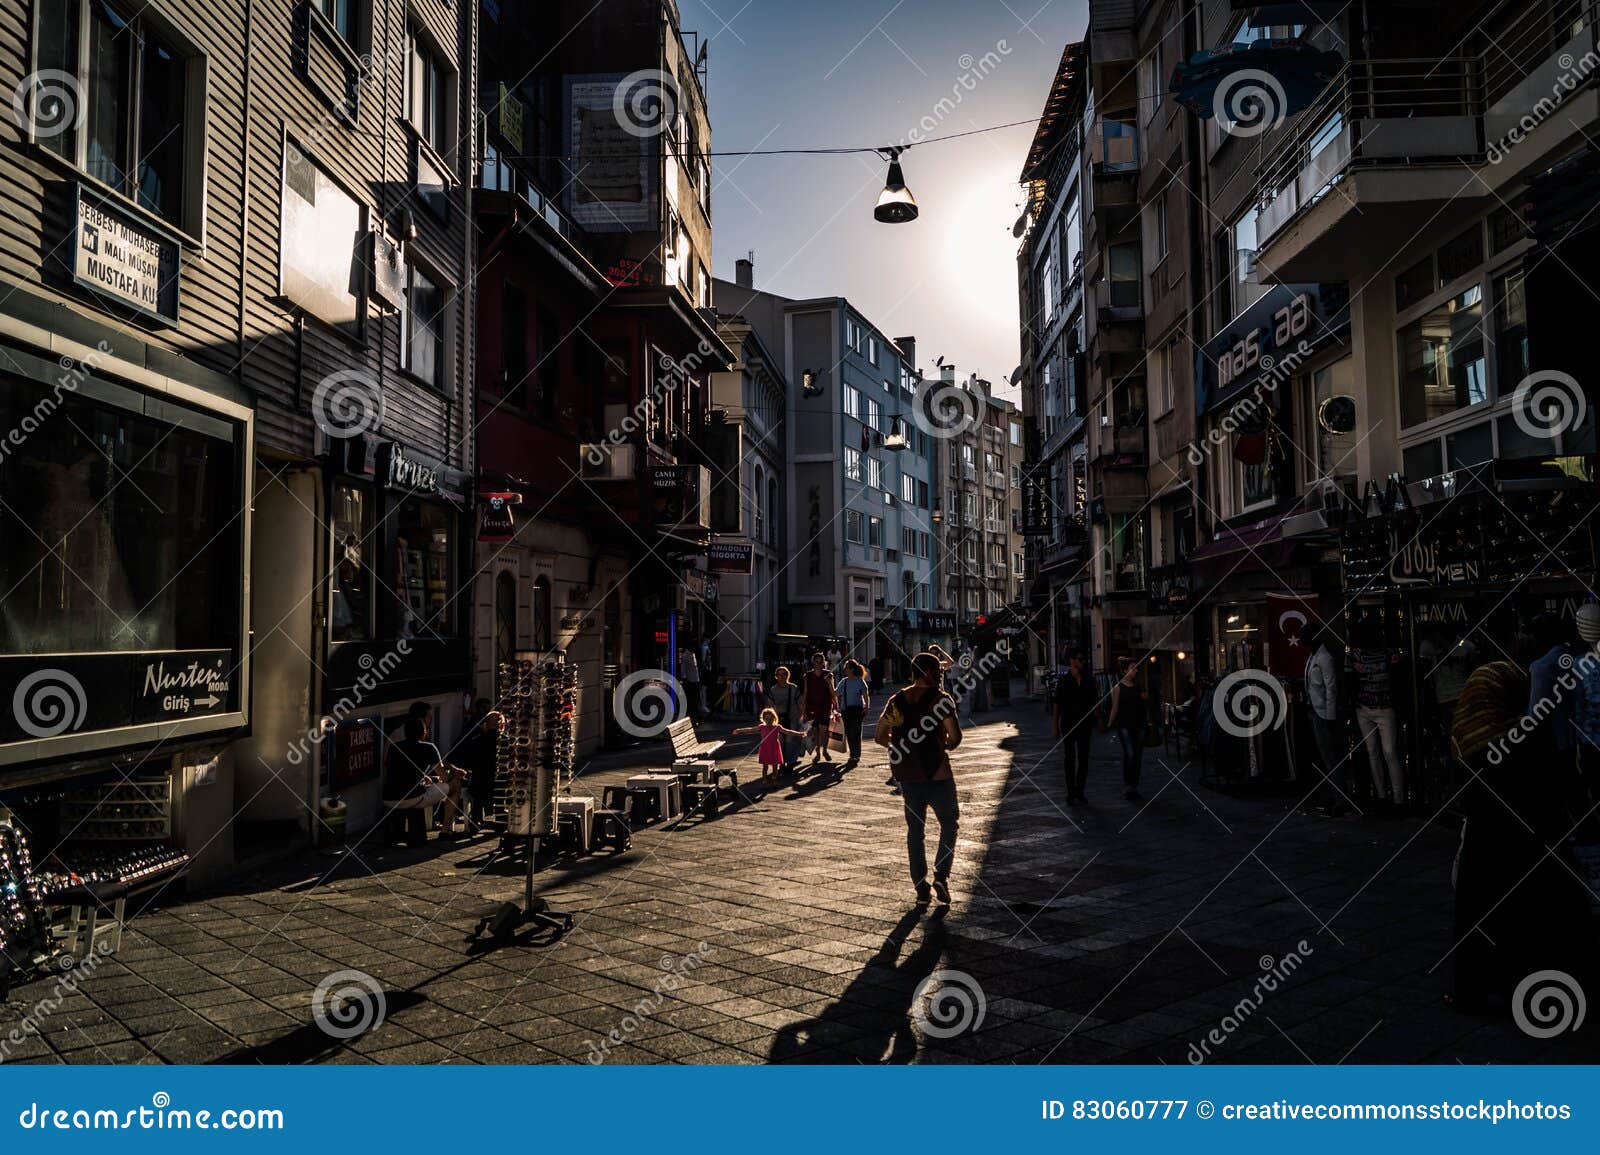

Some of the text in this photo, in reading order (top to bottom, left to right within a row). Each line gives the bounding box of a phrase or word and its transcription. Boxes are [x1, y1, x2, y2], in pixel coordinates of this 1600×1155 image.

[80, 202, 117, 235] SERBEST
[87, 256, 139, 298] MUSTAFA
[711, 545, 750, 554] ANADOLU
[1436, 559, 1480, 584] MEN
[143, 659, 222, 697] Nurten
[208, 681, 229, 692] MODA
[163, 694, 190, 713] Giriş
